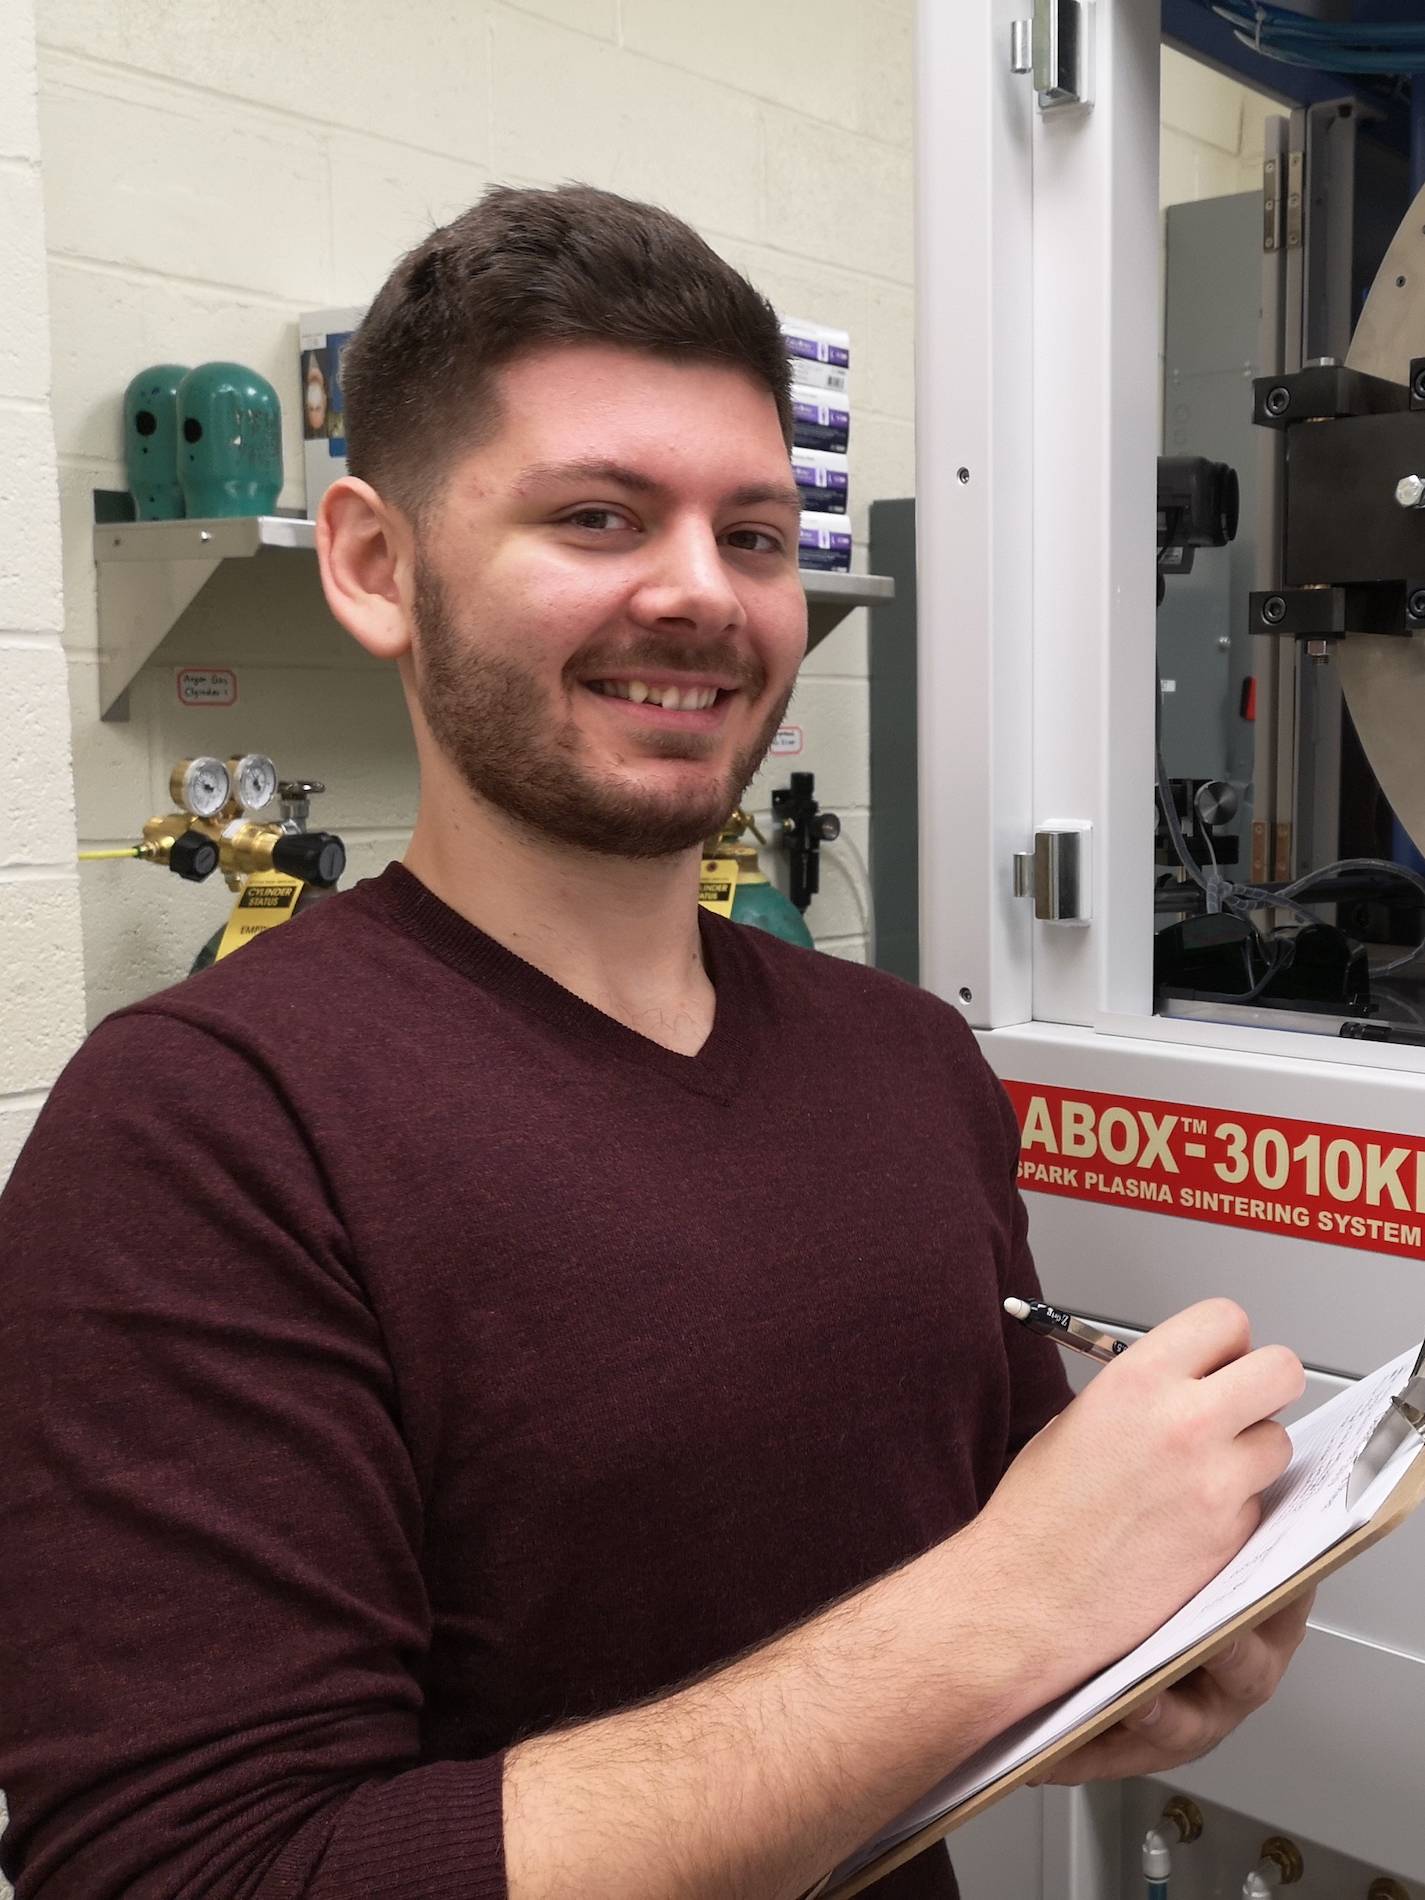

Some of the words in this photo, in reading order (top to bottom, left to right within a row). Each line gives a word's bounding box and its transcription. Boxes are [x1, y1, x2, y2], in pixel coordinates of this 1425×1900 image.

[248, 887, 293, 896] CYLINDER
[248, 897, 279, 906] STATUS
[1084, 1171, 1174, 1204] PLASMA
[1179, 1187, 1310, 1227] SINTERING
[1317, 1210, 1422, 1247] SYSTEM
